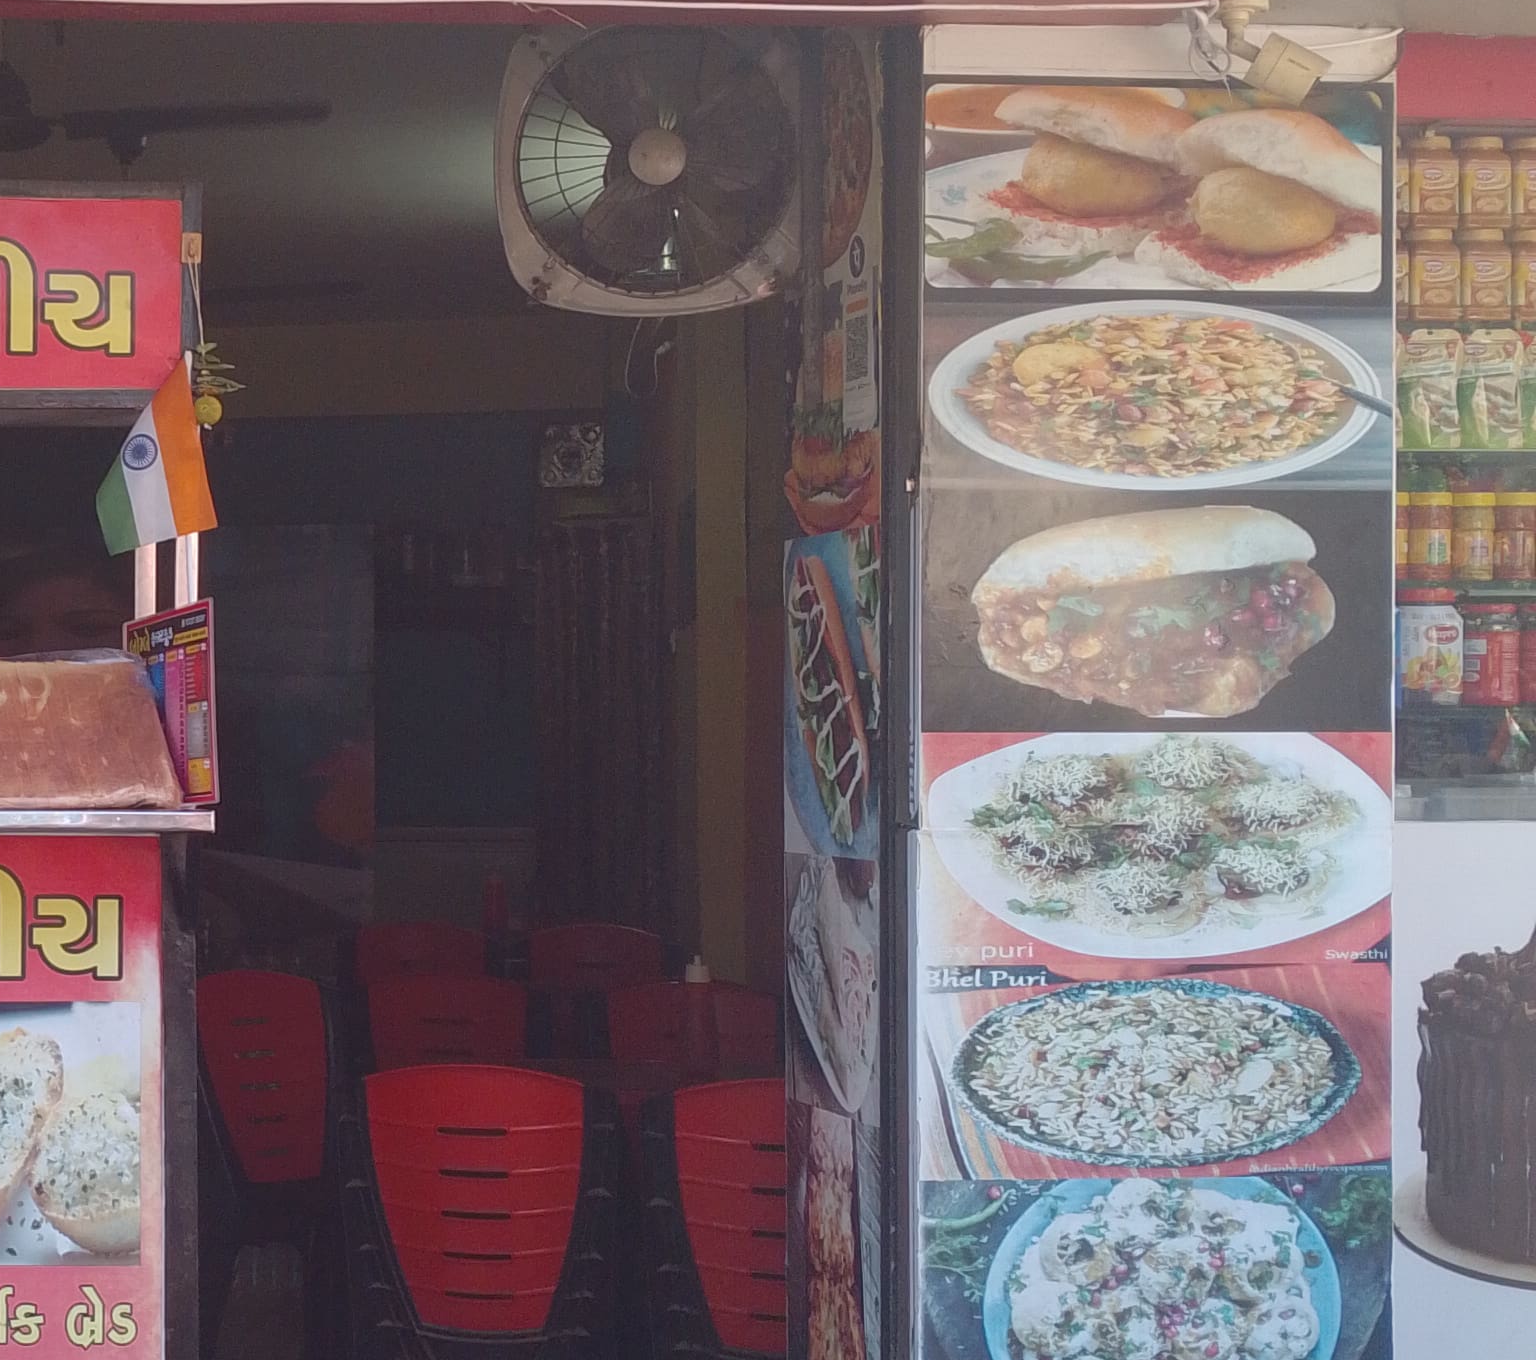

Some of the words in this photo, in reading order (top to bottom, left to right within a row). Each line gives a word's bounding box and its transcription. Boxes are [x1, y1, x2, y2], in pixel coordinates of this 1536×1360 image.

[981, 942, 1034, 961] puri
[1325, 949, 1388, 960] Swasthi
[928, 968, 982, 987] Bhel
[990, 969, 1048, 987] Puri
[65, 1285, 138, 1350] બ્રેડ
